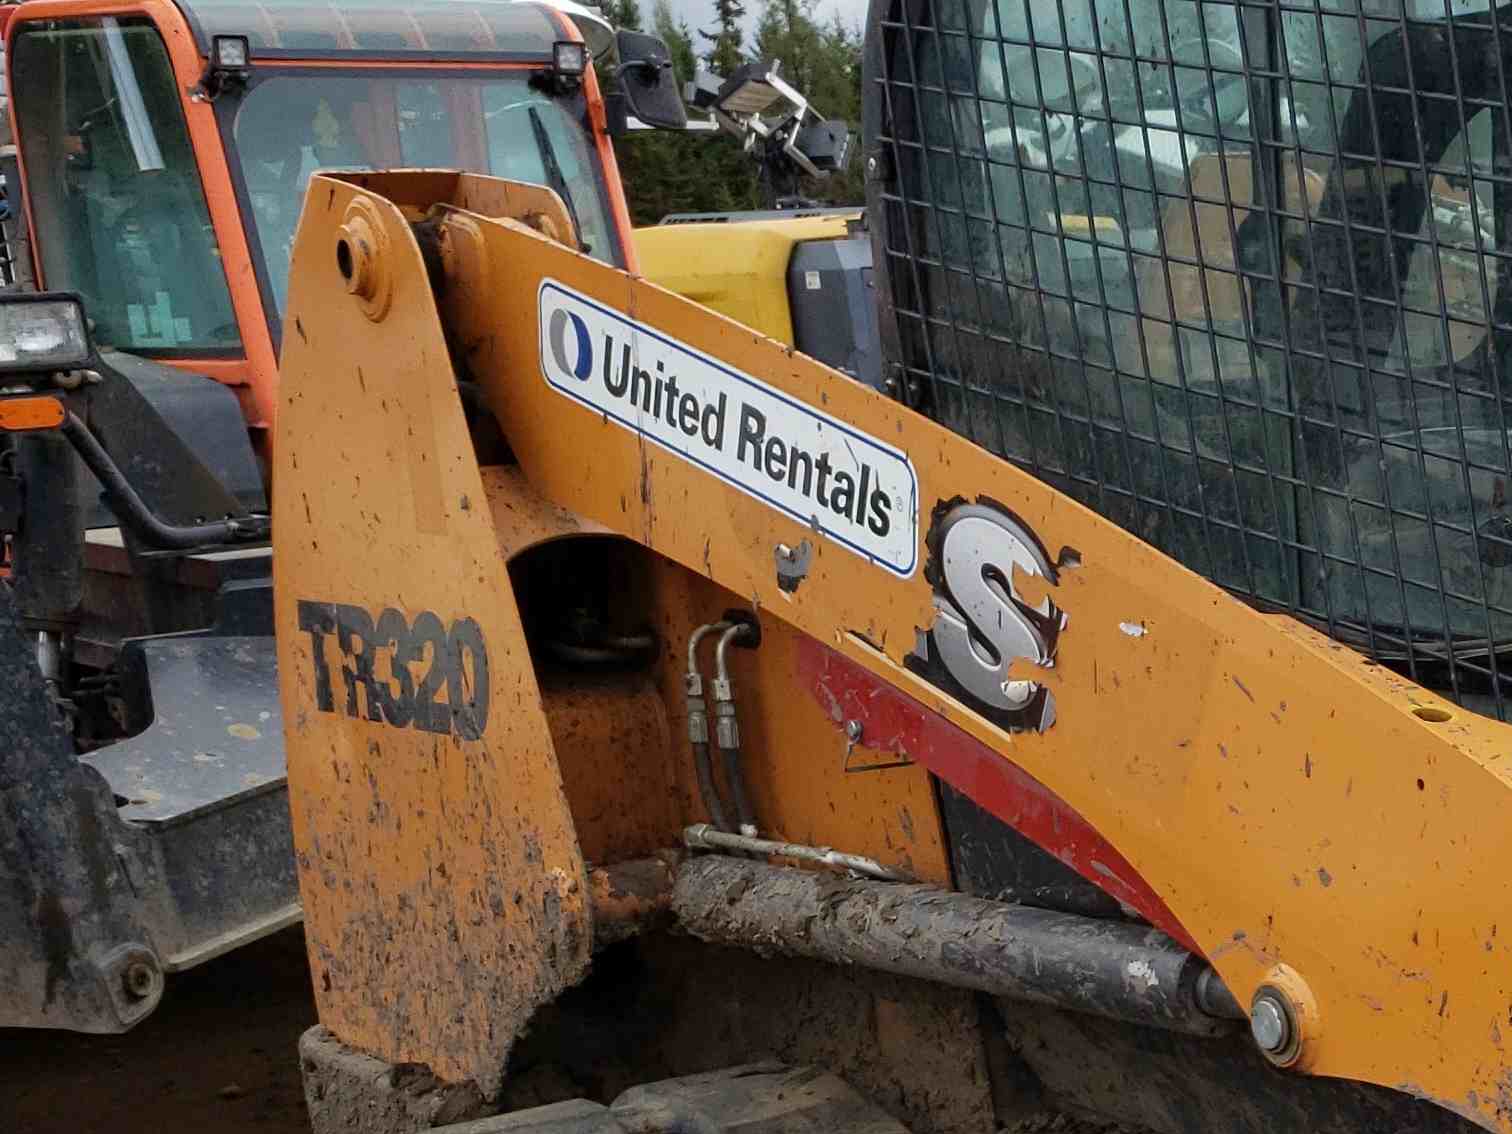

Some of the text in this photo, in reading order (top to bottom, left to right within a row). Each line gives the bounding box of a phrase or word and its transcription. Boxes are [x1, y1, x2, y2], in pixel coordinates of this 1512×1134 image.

[603, 334, 893, 538] United Rentals
[296, 599, 490, 742] TR320
